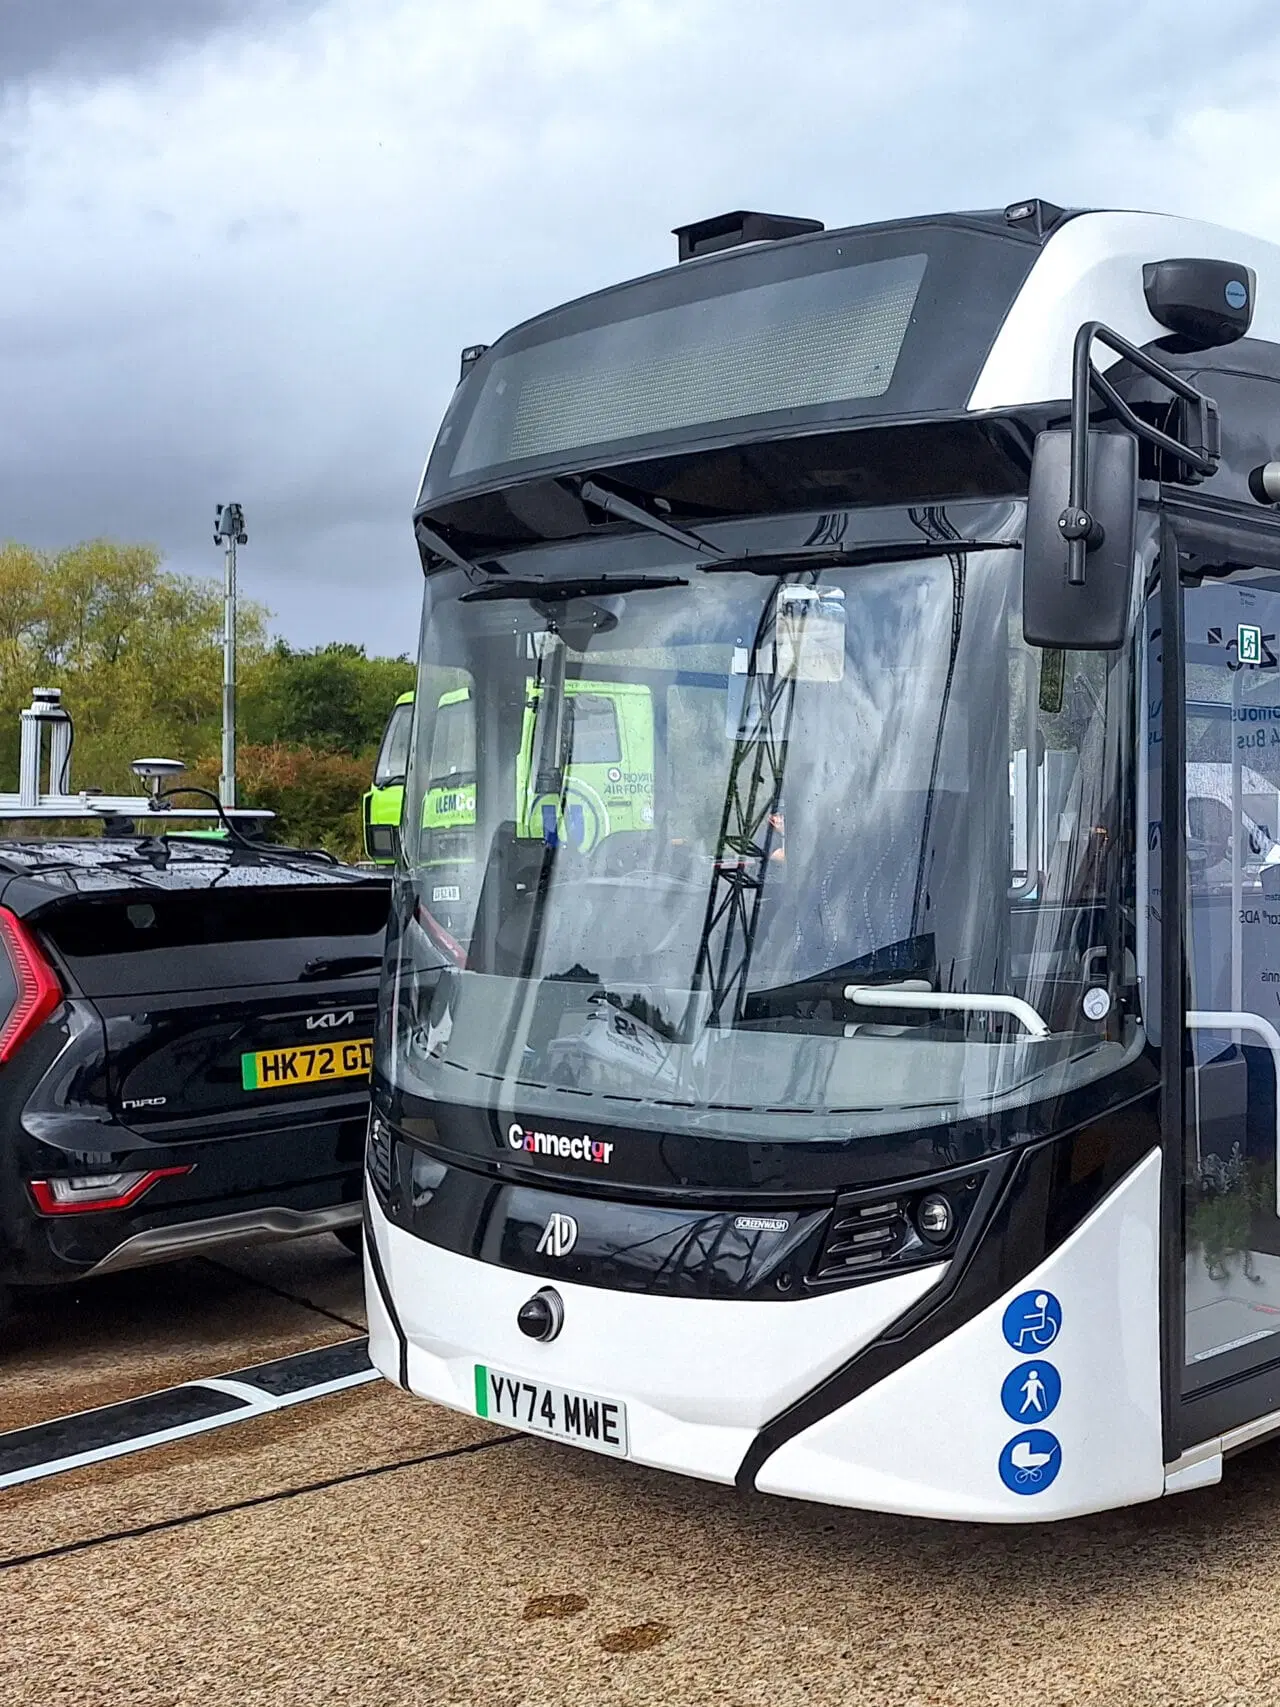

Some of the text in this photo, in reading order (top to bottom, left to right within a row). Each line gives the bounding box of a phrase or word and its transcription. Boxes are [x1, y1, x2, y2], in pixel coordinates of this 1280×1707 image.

[306, 1011, 355, 1030] KIA
[262, 1047, 336, 1082] HK72
[508, 1123, 614, 1165] Connector
[736, 1218, 787, 1232] SCREENWASH
[490, 1373, 620, 1446] YY74 MWE
